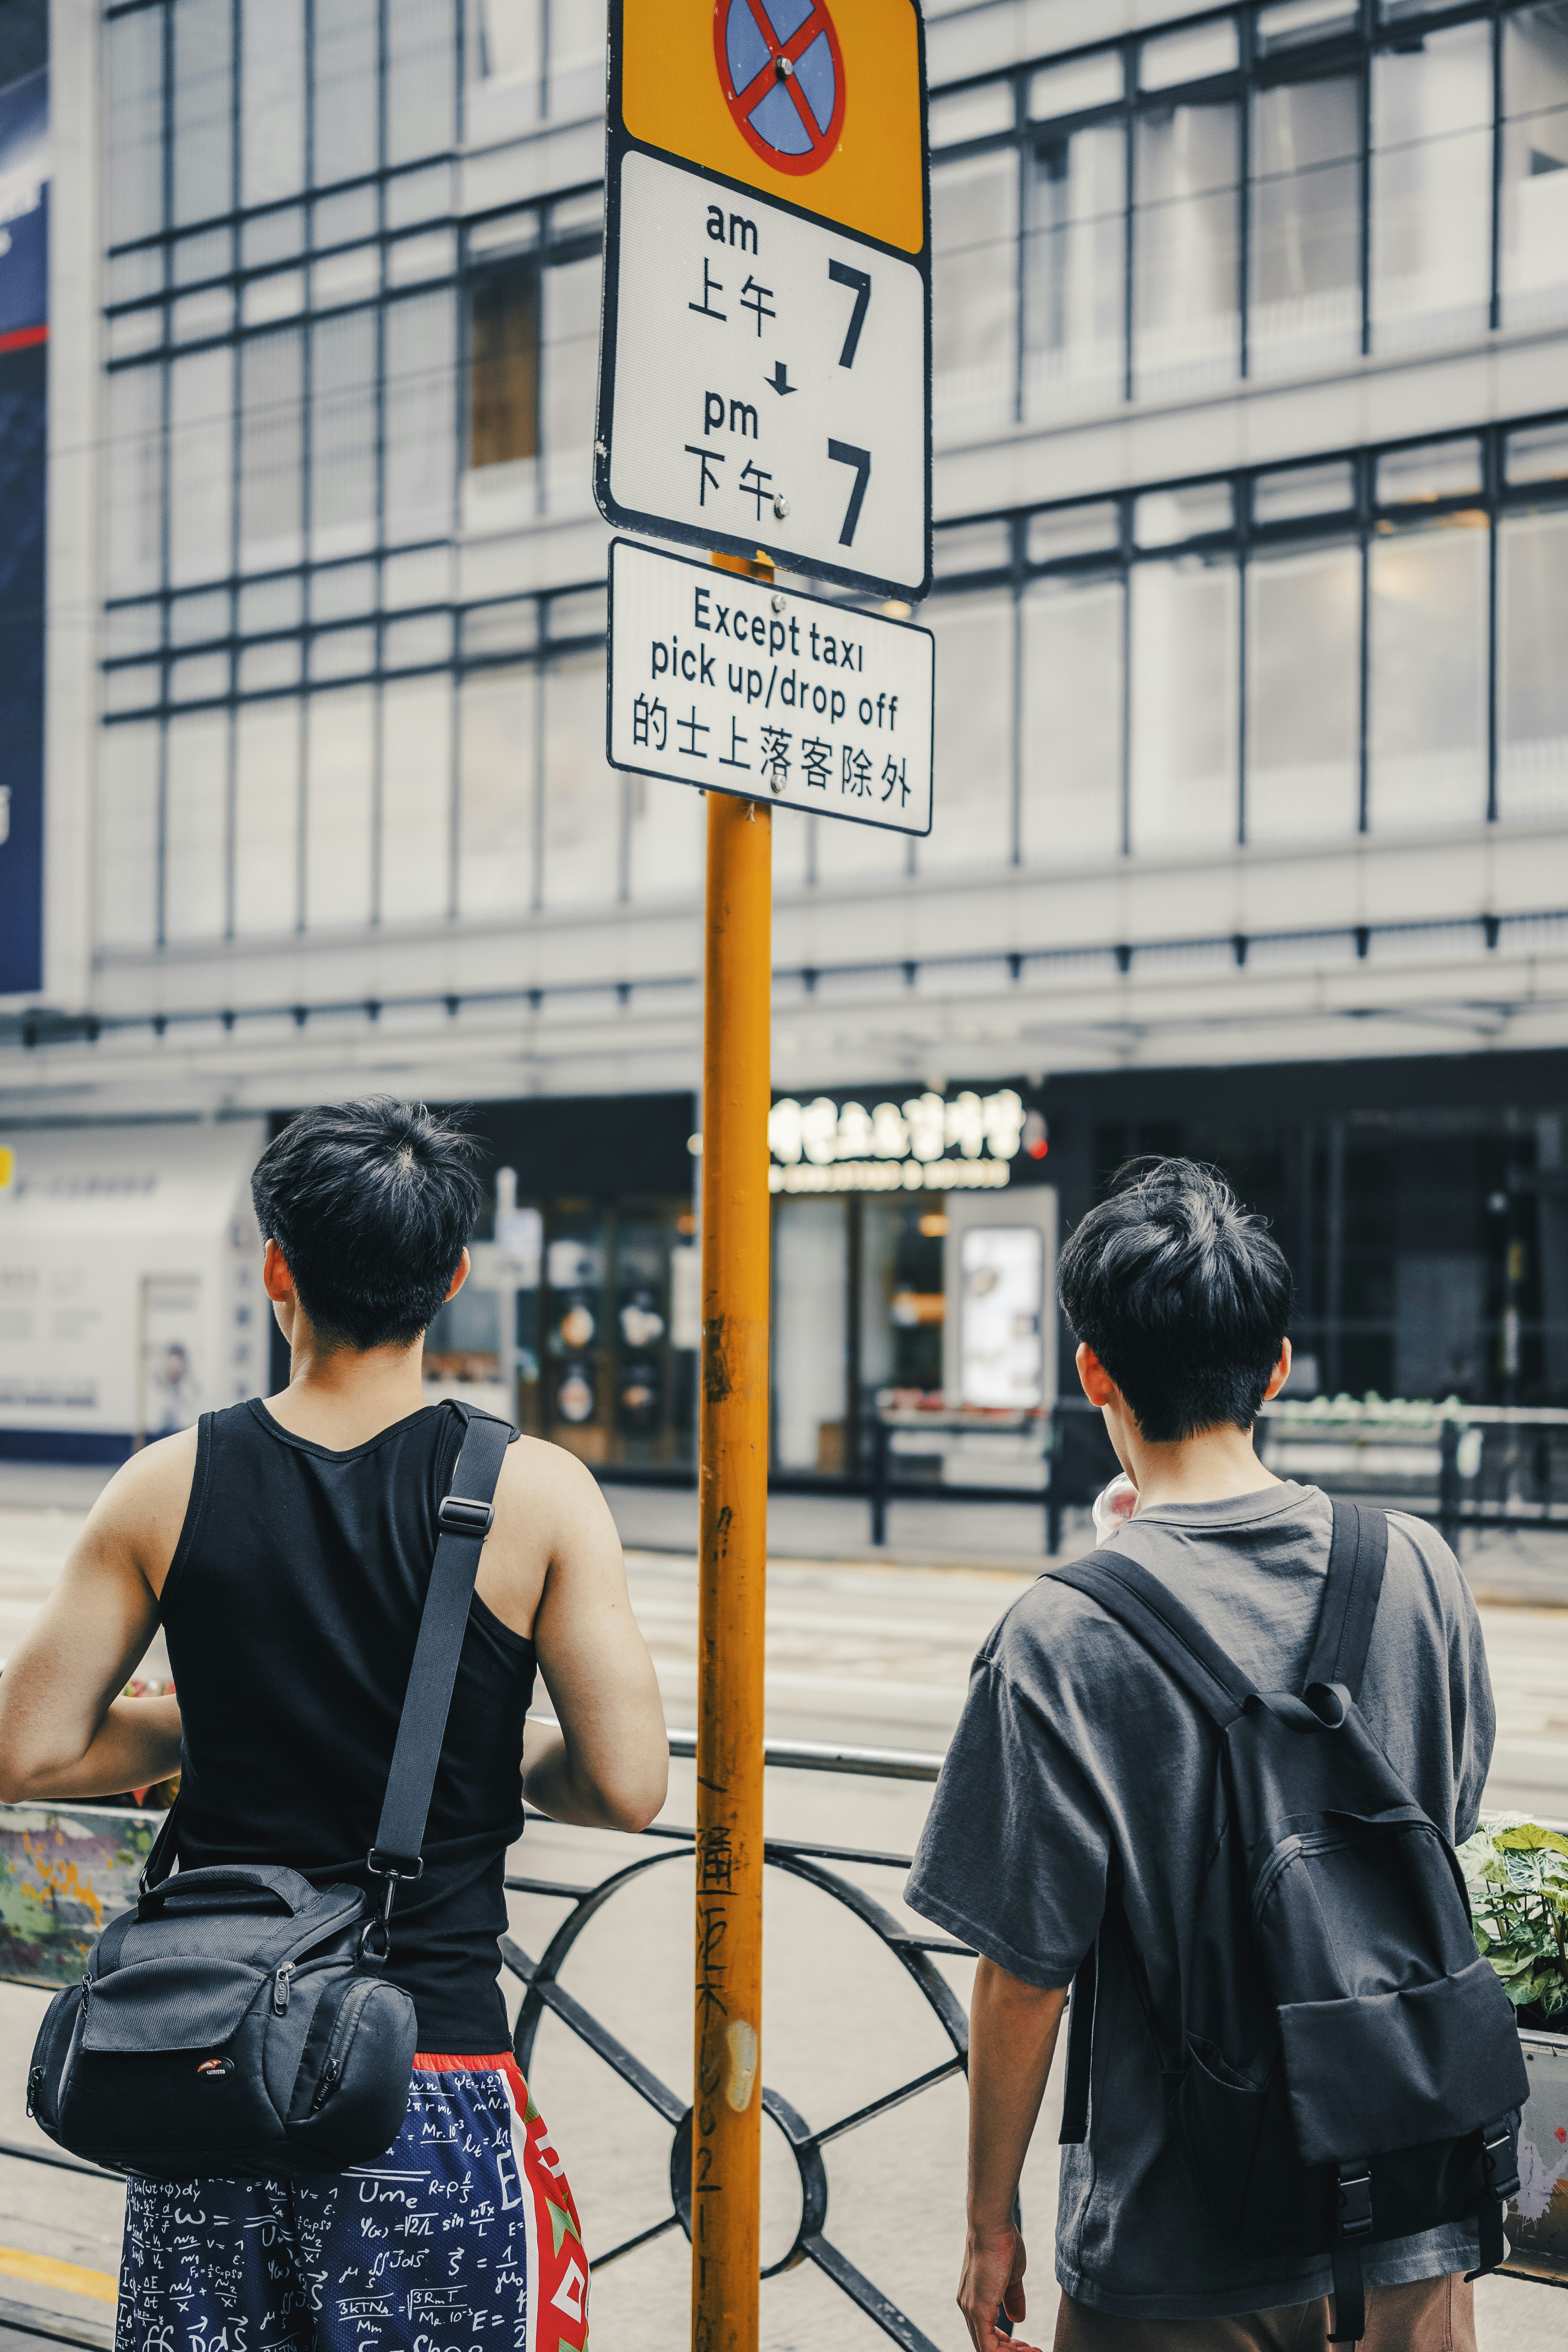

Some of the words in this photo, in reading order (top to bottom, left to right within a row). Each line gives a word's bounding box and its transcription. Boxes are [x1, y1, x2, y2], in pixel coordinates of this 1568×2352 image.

[706, 204, 758, 255] am
[689, 257, 776, 337] 上午
[828, 258, 871, 369] 7
[705, 391, 759, 439] pm
[685, 444, 774, 521] 下午
[828, 438, 871, 547] 7
[694, 587, 800, 657] Except
[652, 635, 716, 687] pick
[729, 665, 846, 724] up/drop
[859, 693, 899, 731] off
[633, 692, 912, 808] 的士上落客除外
[443, 2212, 464, 2231] sin
